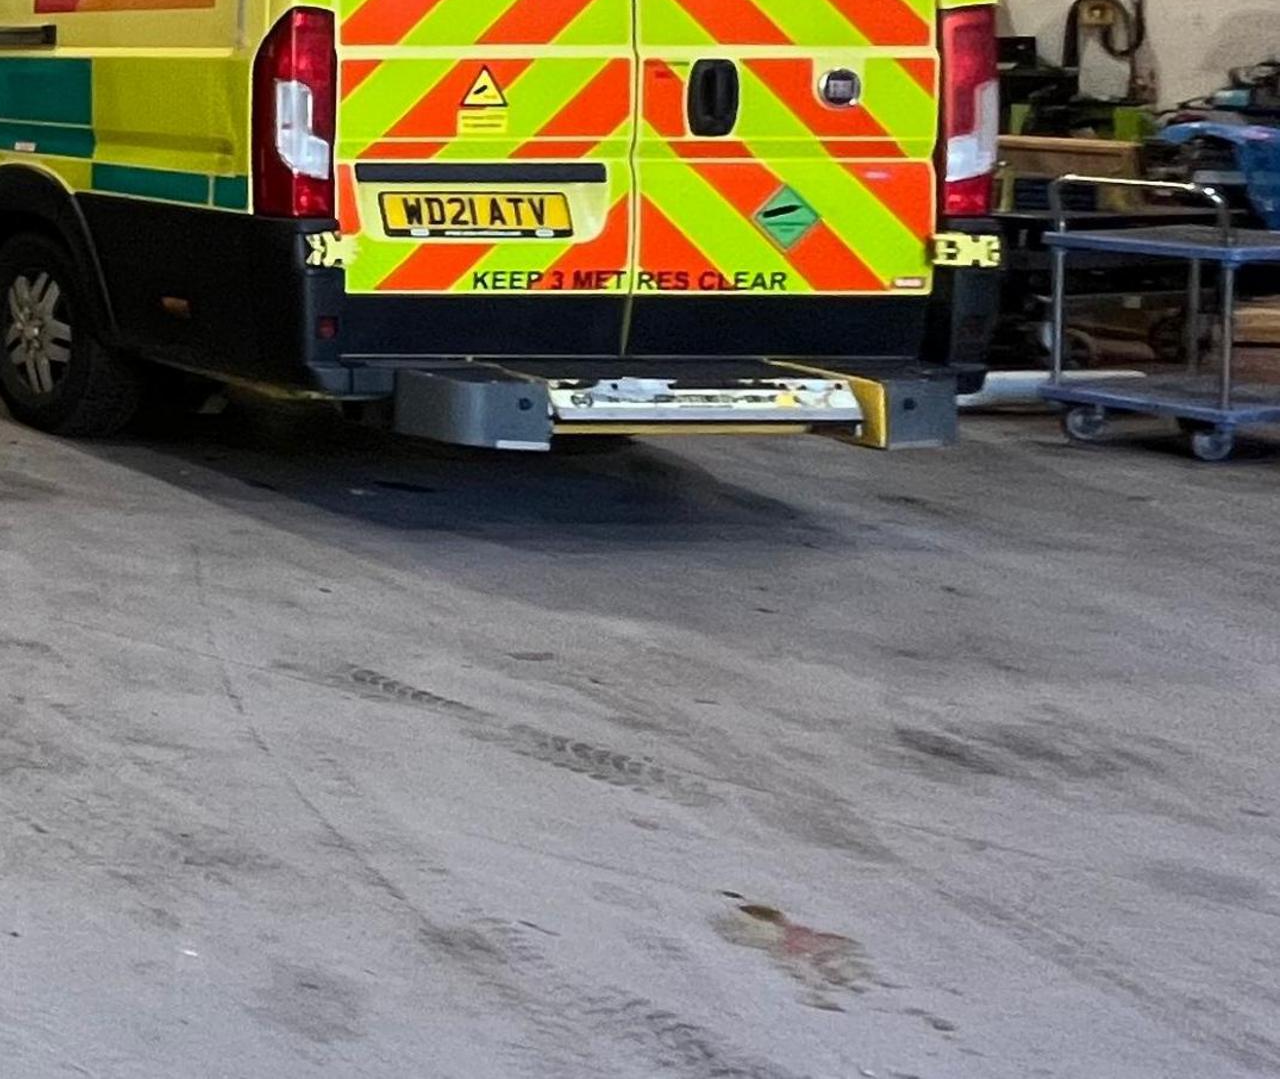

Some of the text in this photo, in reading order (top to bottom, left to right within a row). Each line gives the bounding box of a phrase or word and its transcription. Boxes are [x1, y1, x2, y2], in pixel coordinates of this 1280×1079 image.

[402, 197, 545, 226] WD21 ATV
[472, 270, 788, 291] KEEP 3 METRES CLEAR
